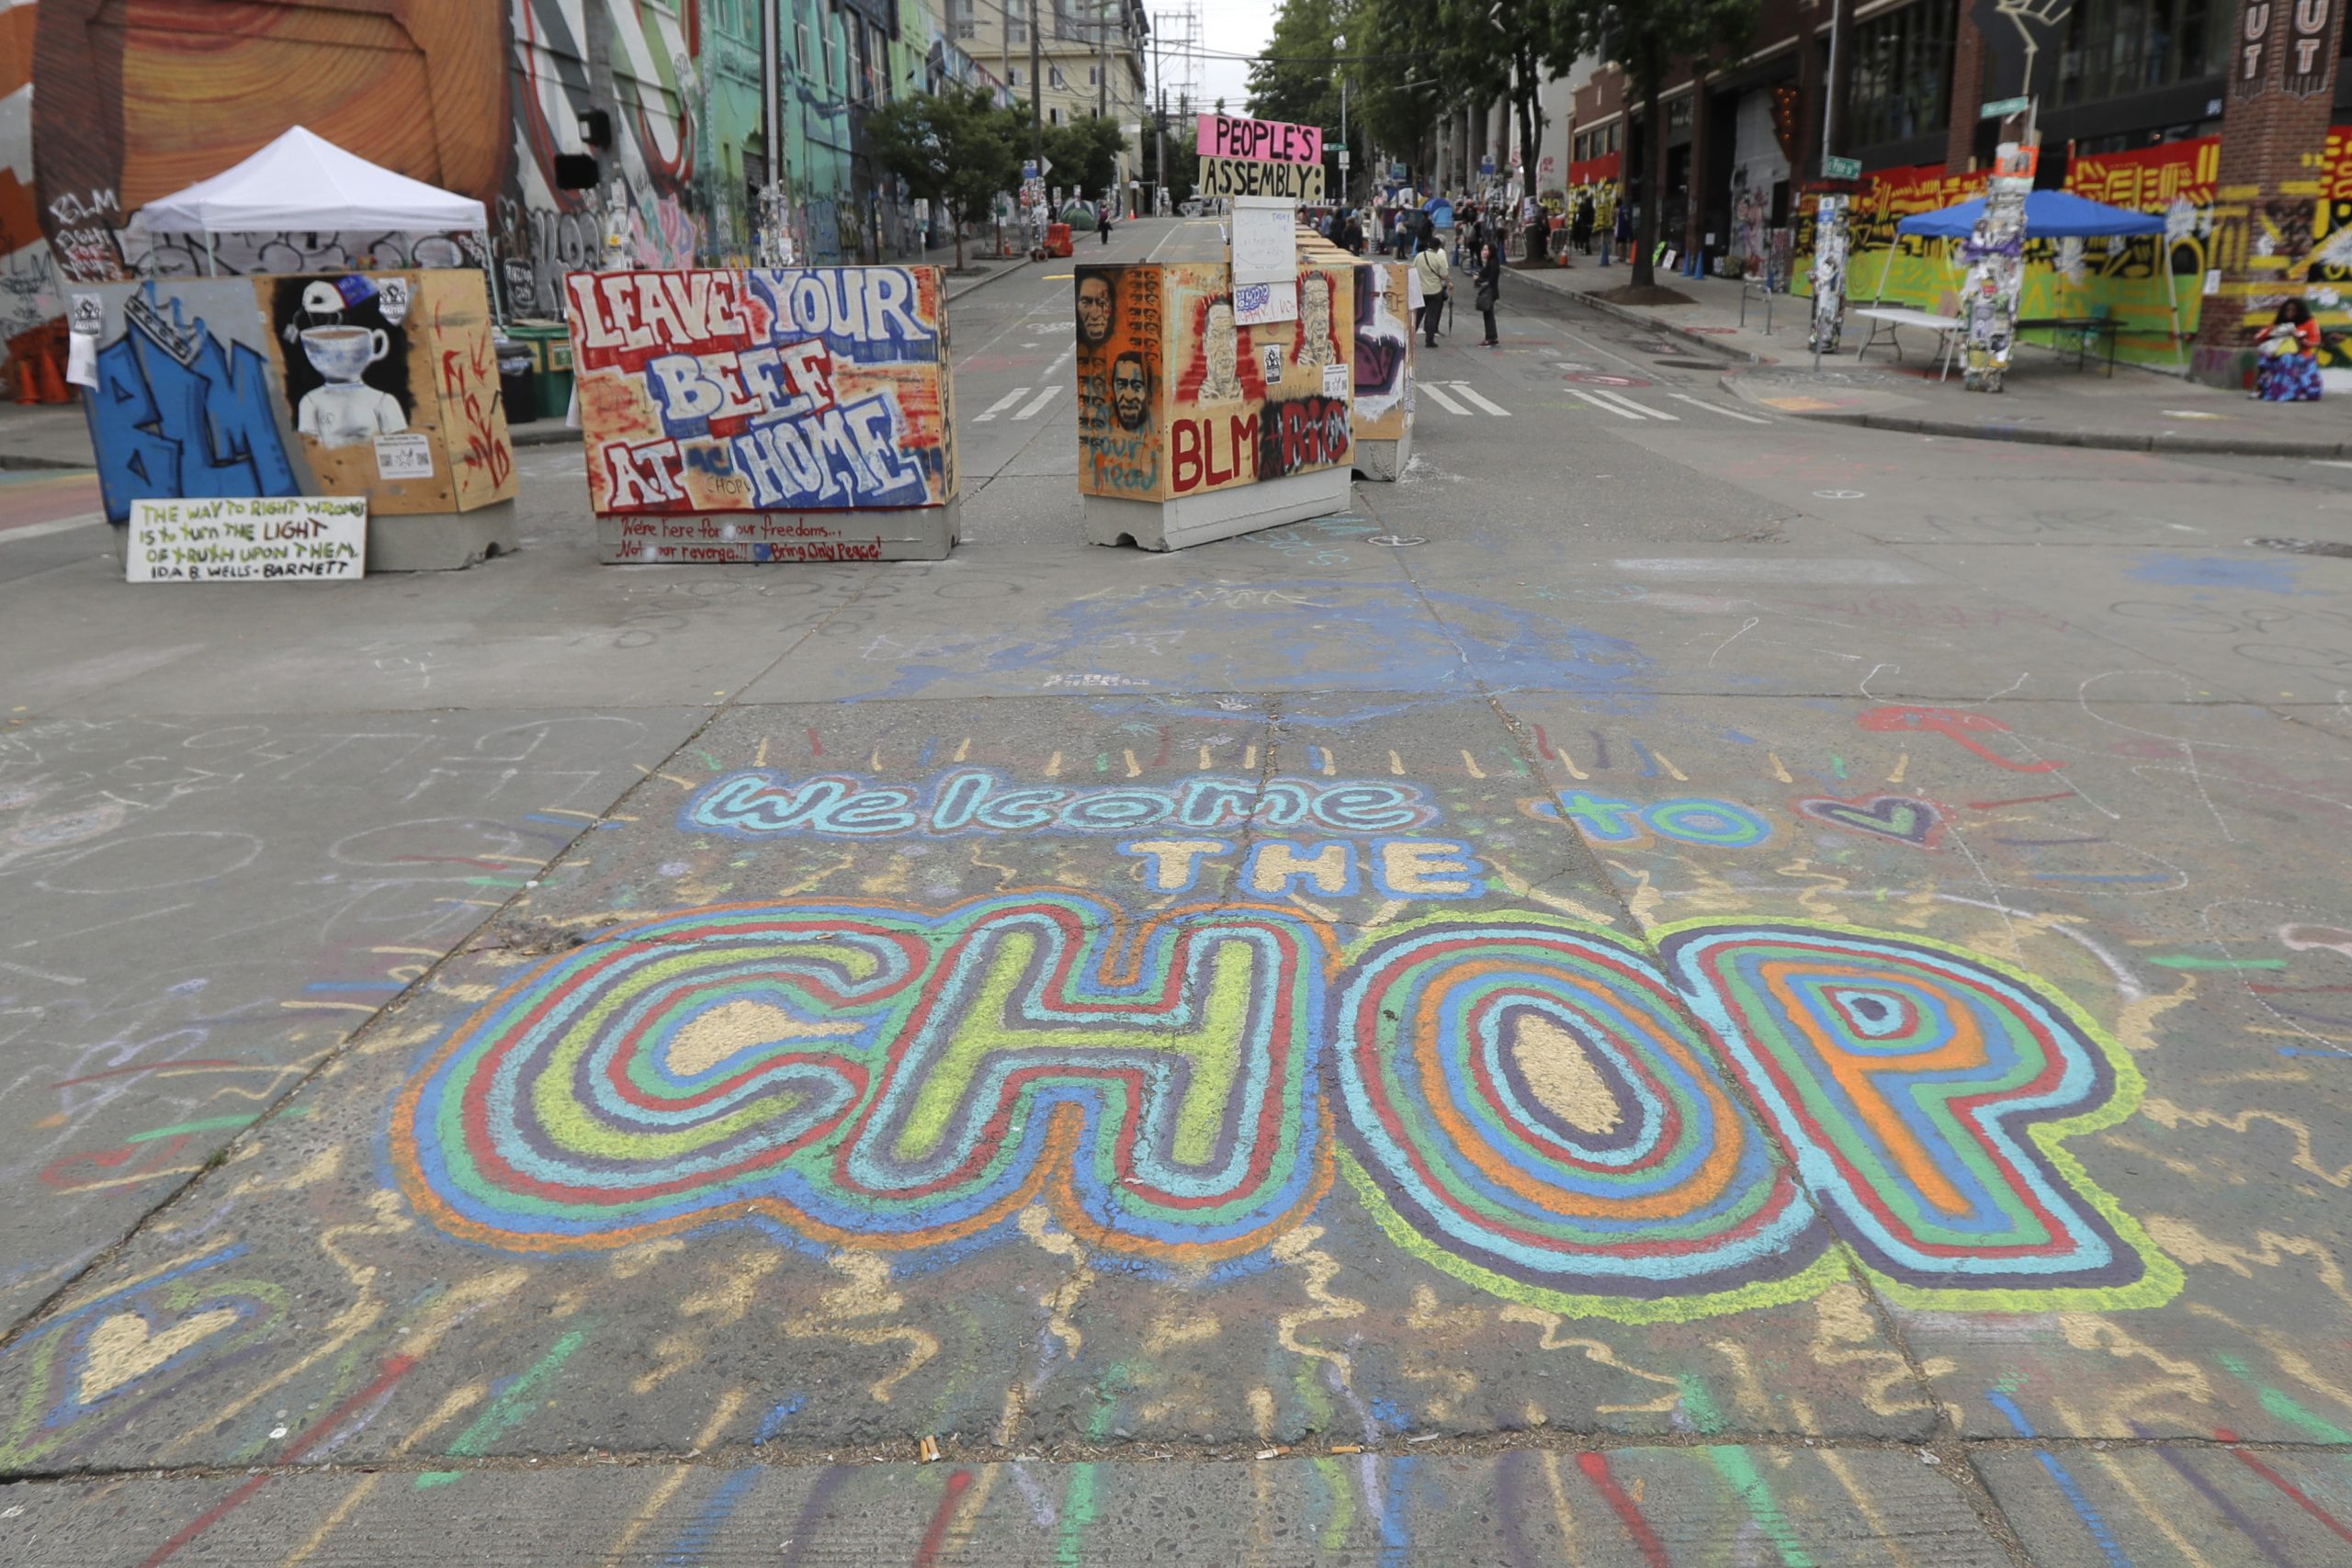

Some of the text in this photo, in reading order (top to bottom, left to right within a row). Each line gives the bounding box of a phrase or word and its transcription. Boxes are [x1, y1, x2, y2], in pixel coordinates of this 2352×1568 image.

[1216, 117, 1314, 162] PEOPLE'S
[1204, 158, 1321, 198] ASSEMBLY:
[49, 188, 121, 225] BLM
[570, 272, 748, 353] LEAVE
[748, 266, 935, 342] YOUR
[650, 341, 834, 424] BEEF
[605, 397, 917, 508] AT HOME
[1171, 413, 1259, 492] BLM
[139, 530, 155, 546] IS
[223, 523, 254, 541] THE
[264, 517, 328, 540] LIGHT
[141, 504, 177, 525] THE
[187, 501, 221, 520] WAY
[250, 499, 300, 515] RIGHT
[621, 515, 658, 536] We're
[662, 518, 695, 537] here
[698, 517, 720, 537] for
[146, 549, 167, 562] OF
[240, 547, 288, 562] UPON
[616, 539, 644, 558] Not
[771, 542, 806, 562] Bring
[808, 542, 835, 561] Only
[836, 536, 882, 559] Peace!
[152, 566, 183, 579] IDA
[1525, 788, 1775, 849] to
[1118, 837, 1488, 901] THE
[390, 887, 2185, 1325] CHOP
